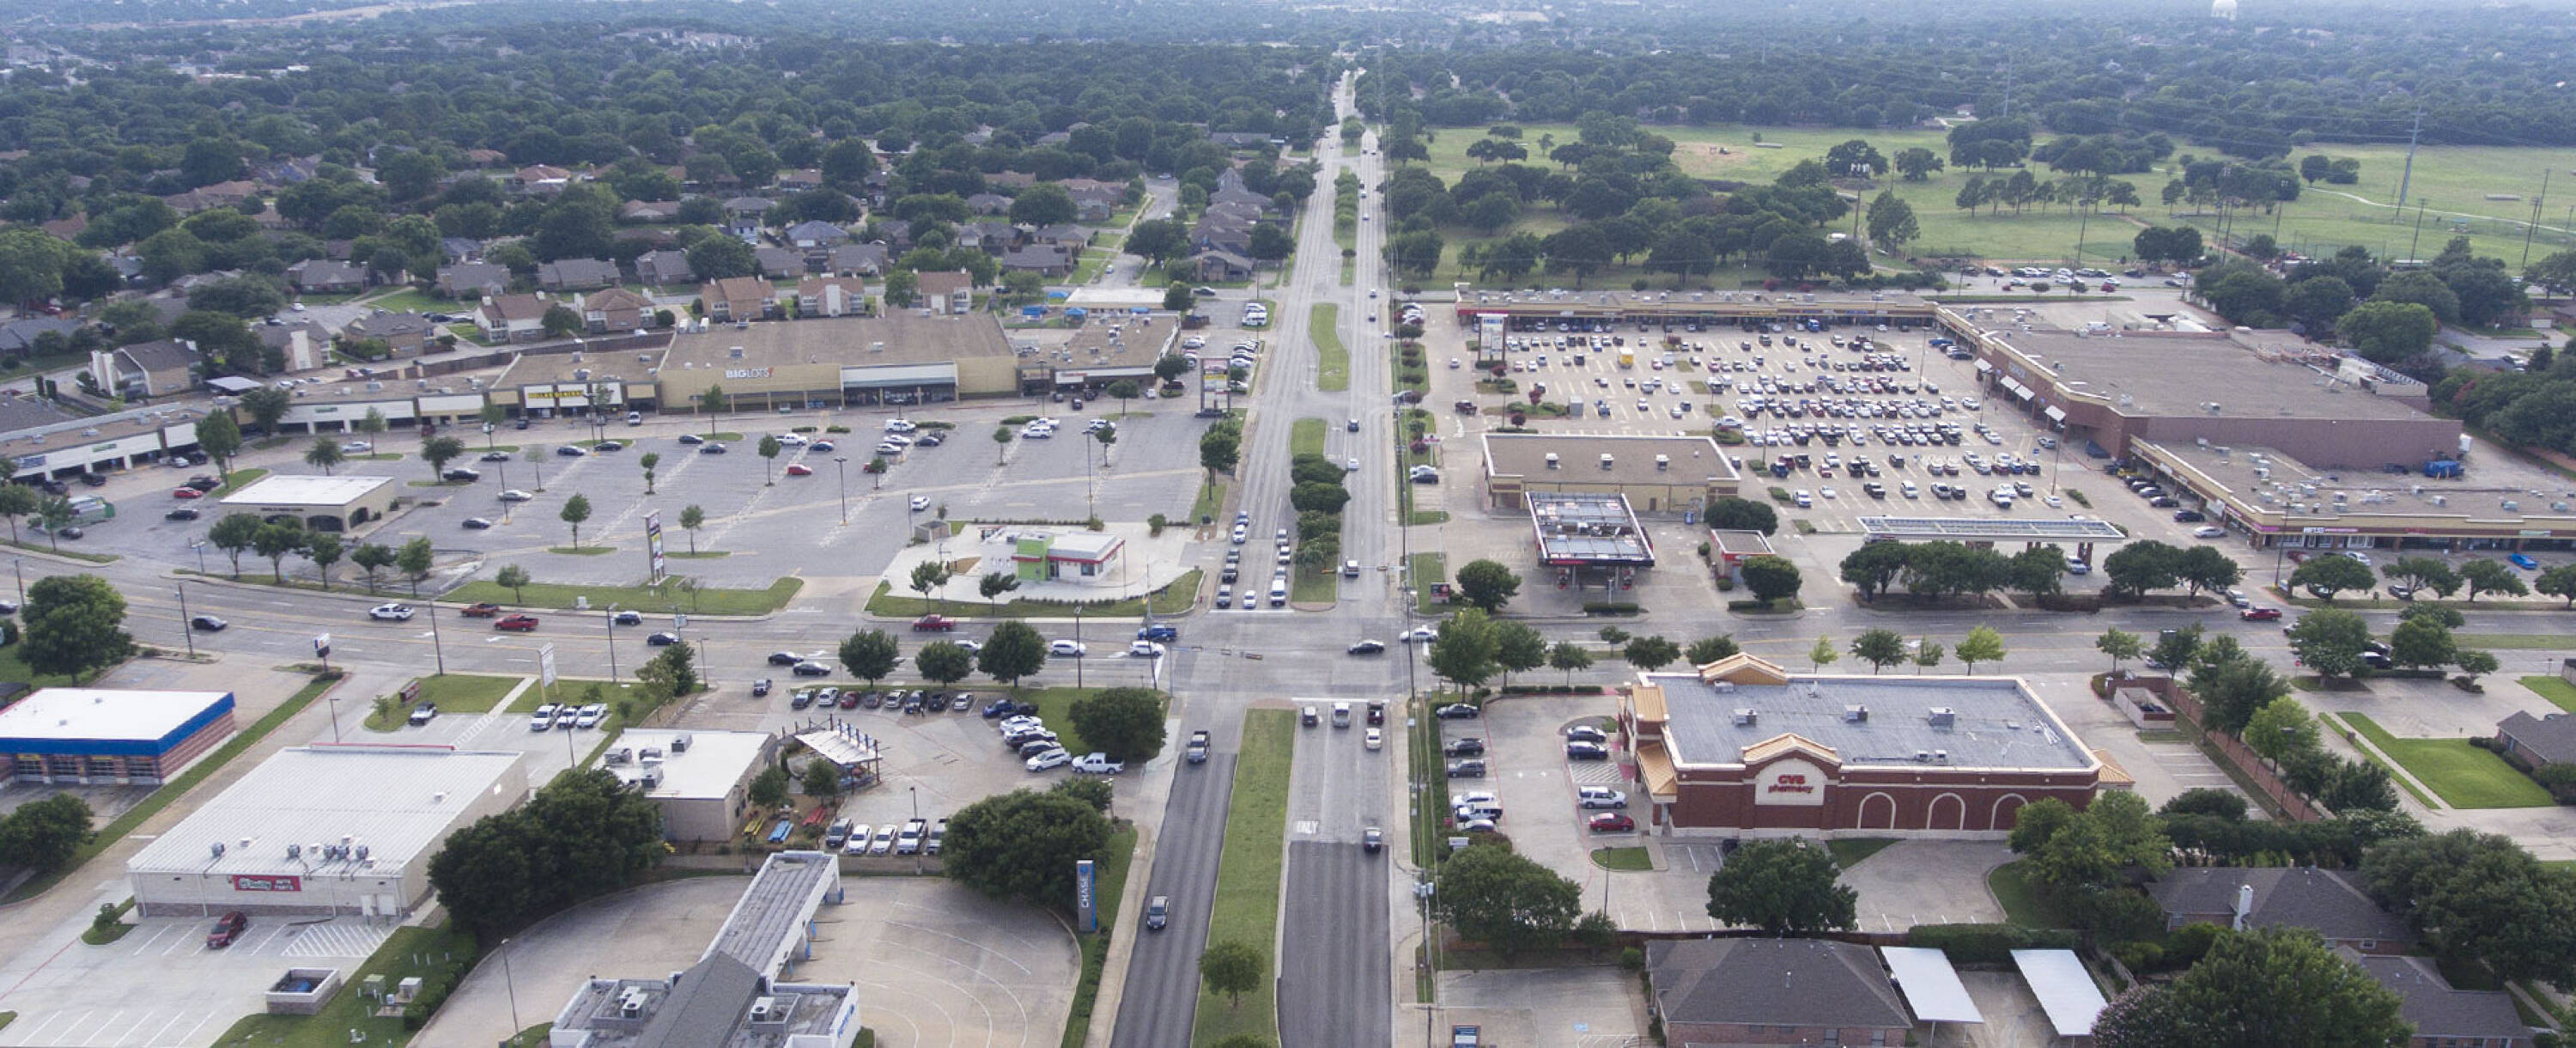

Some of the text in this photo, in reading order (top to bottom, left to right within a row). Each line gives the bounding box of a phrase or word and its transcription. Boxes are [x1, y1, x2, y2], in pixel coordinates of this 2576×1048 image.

[1778, 775, 1806, 784] CVS
[1768, 785, 1814, 795] pharmacy
[1080, 876, 1091, 908] CHASE
